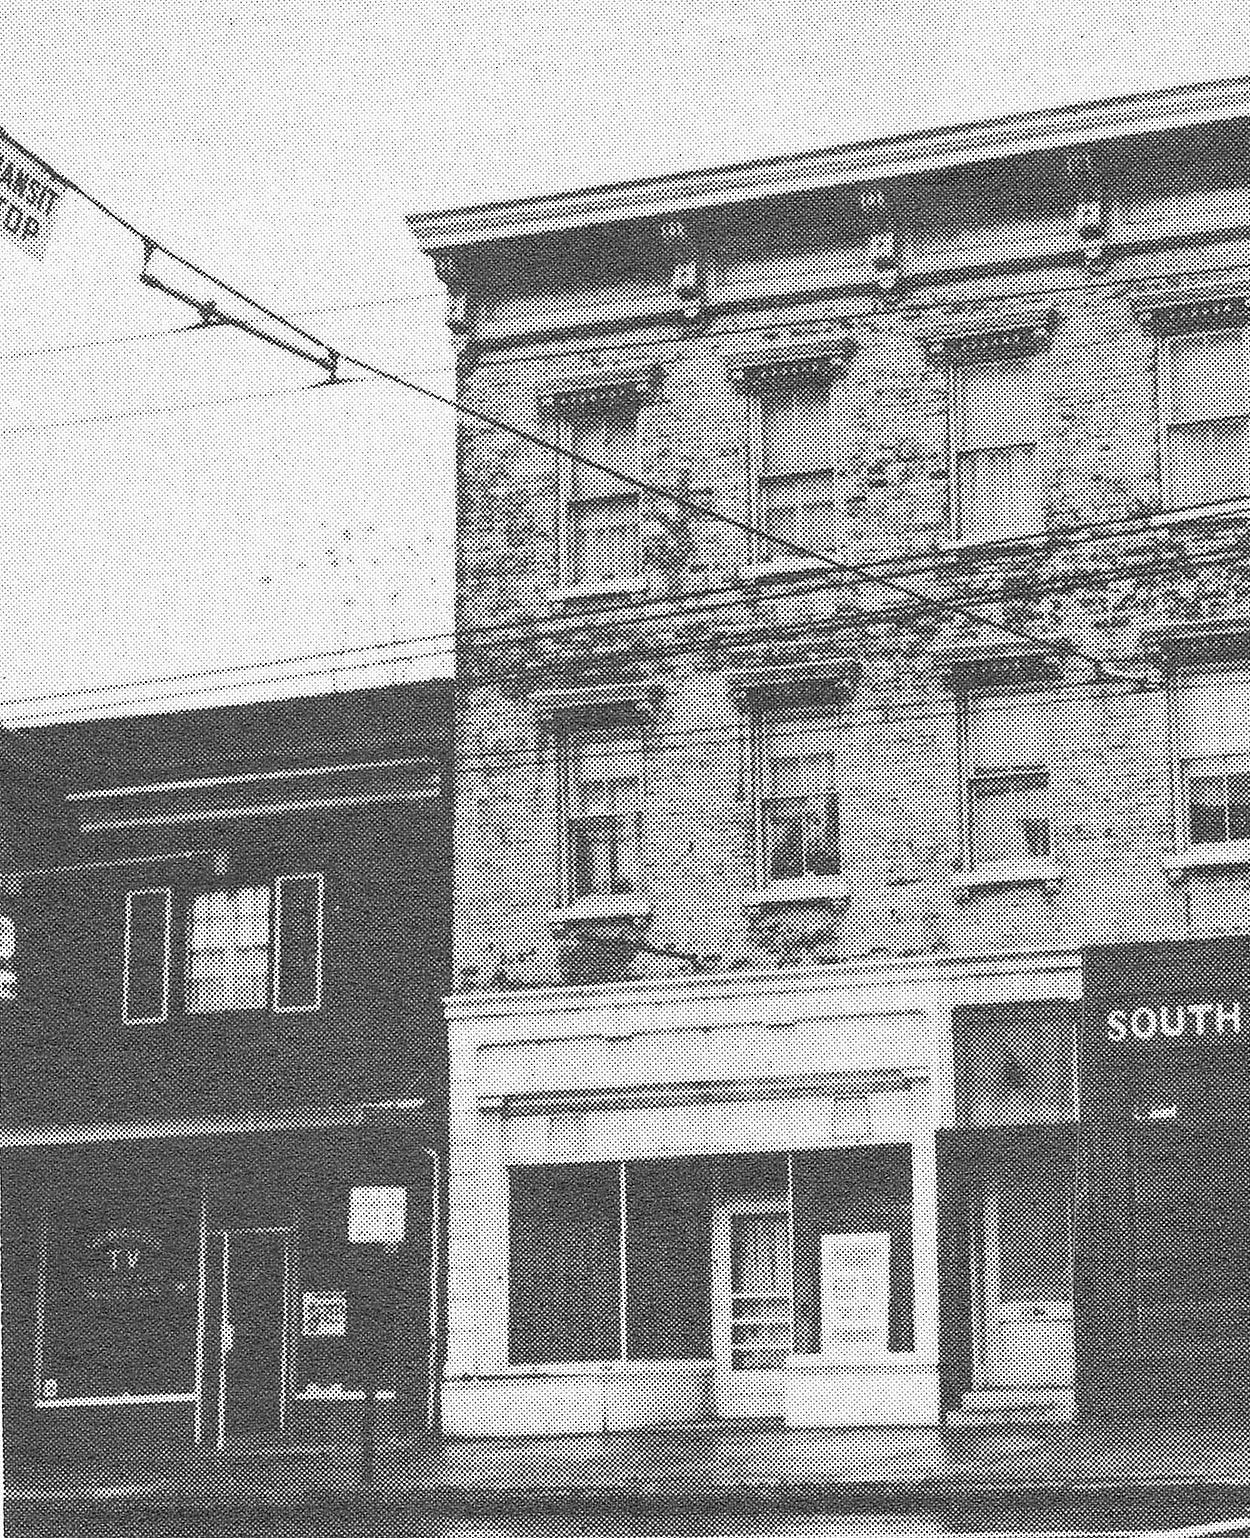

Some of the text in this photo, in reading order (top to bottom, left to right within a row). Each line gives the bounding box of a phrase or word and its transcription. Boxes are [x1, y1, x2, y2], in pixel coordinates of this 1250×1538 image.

[0, 154, 59, 217] ANSIT
[0, 196, 41, 240] OP
[1107, 1001, 1241, 1042] SOUTH
[107, 1248, 141, 1271] TV
